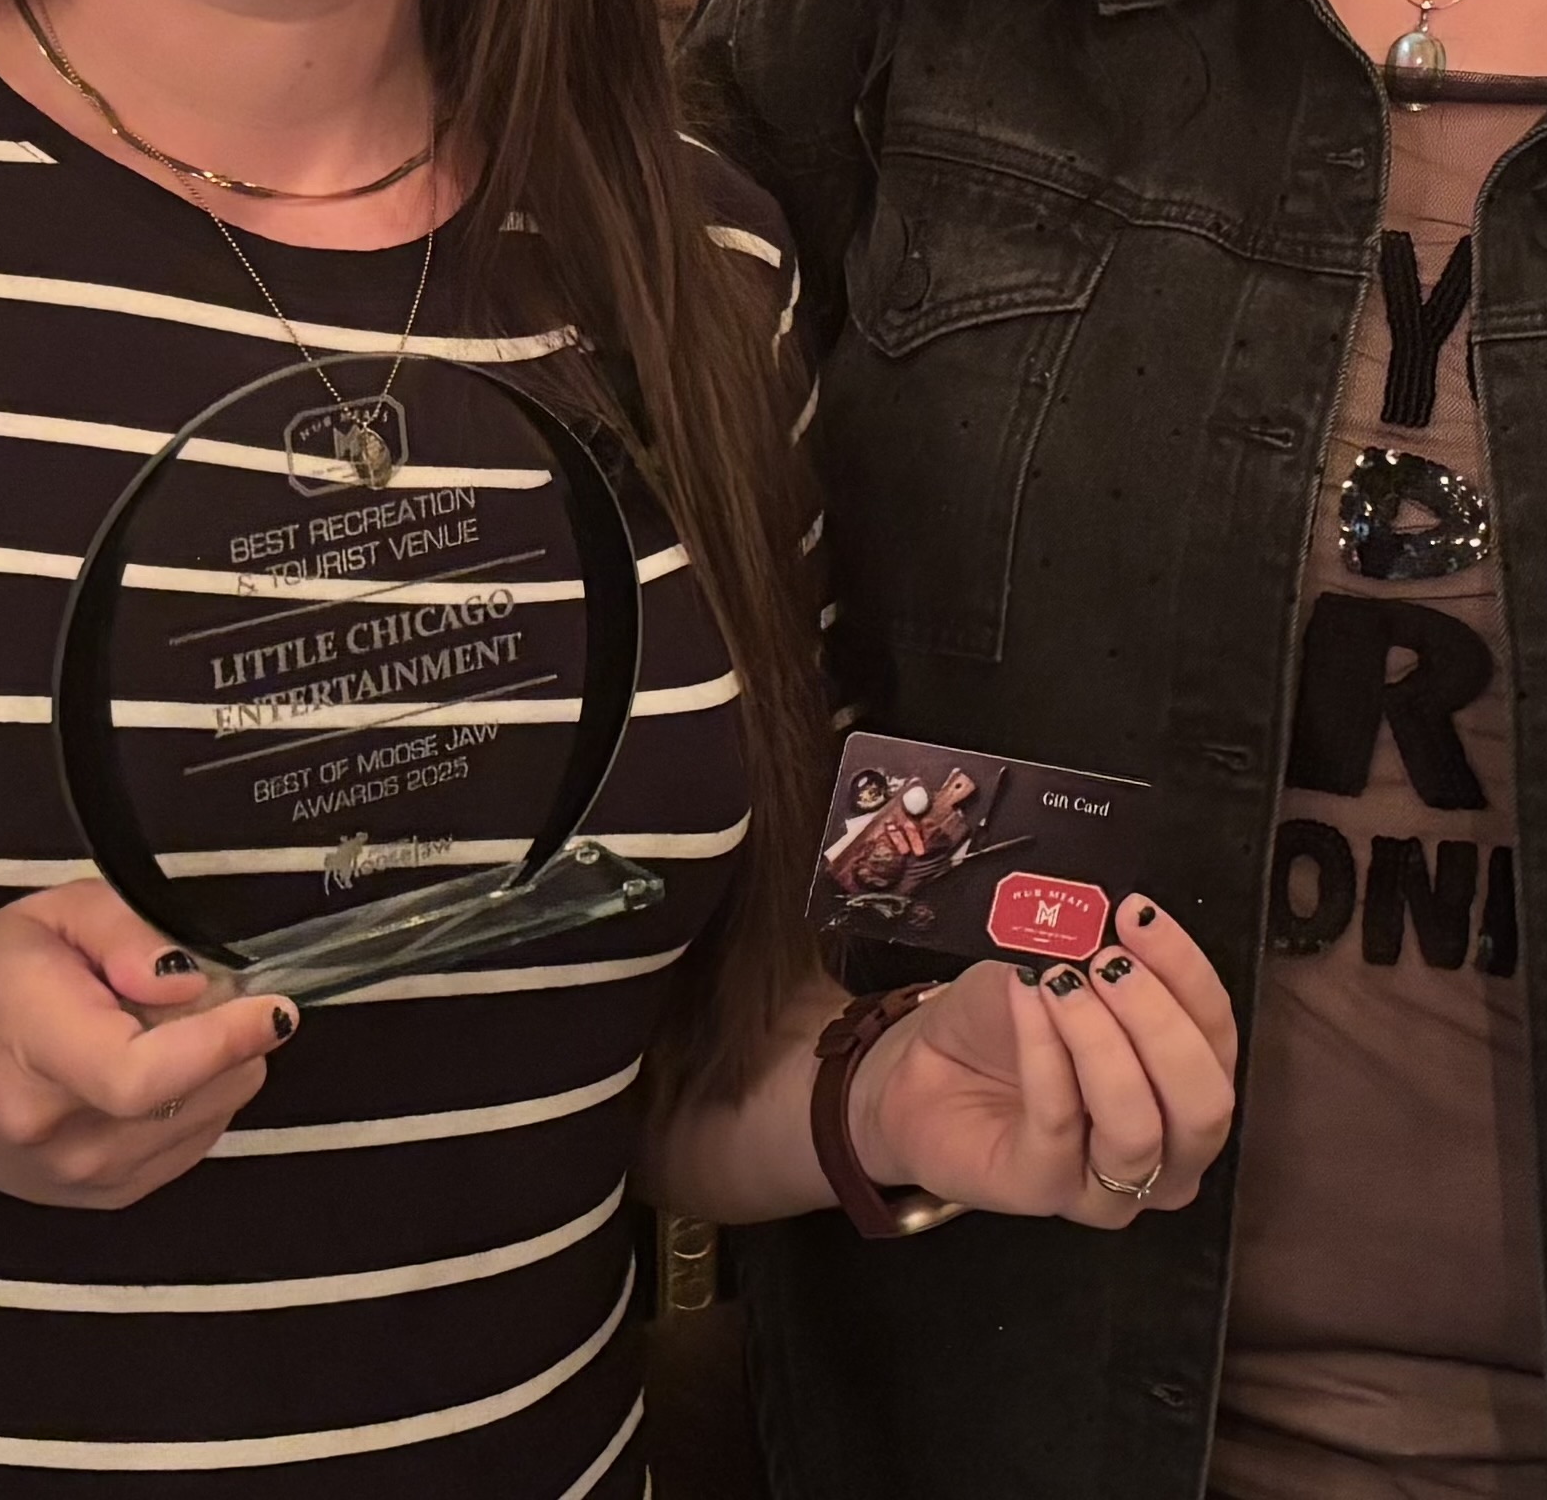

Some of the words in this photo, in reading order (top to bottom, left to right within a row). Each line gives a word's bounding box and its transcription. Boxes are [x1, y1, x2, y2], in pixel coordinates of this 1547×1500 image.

[1379, 229, 1480, 426] Y
[230, 523, 300, 564] BEST
[308, 486, 476, 545] RECREATION
[237, 573, 258, 596] &
[266, 540, 380, 589] TOURIST
[388, 518, 480, 561] VENUE
[210, 630, 338, 690] LITTLE
[346, 588, 516, 655] CHICAGO
[213, 632, 523, 739] ENTERTAINMENT
[253, 767, 312, 803] BEST
[319, 758, 349, 785] OF
[357, 733, 439, 775] MOOSE
[444, 720, 500, 752] JAW
[291, 775, 400, 822] AWARDS
[406, 755, 470, 792] 2025
[1073, 796, 1111, 817] Card
[1012, 887, 1042, 901] HUB
